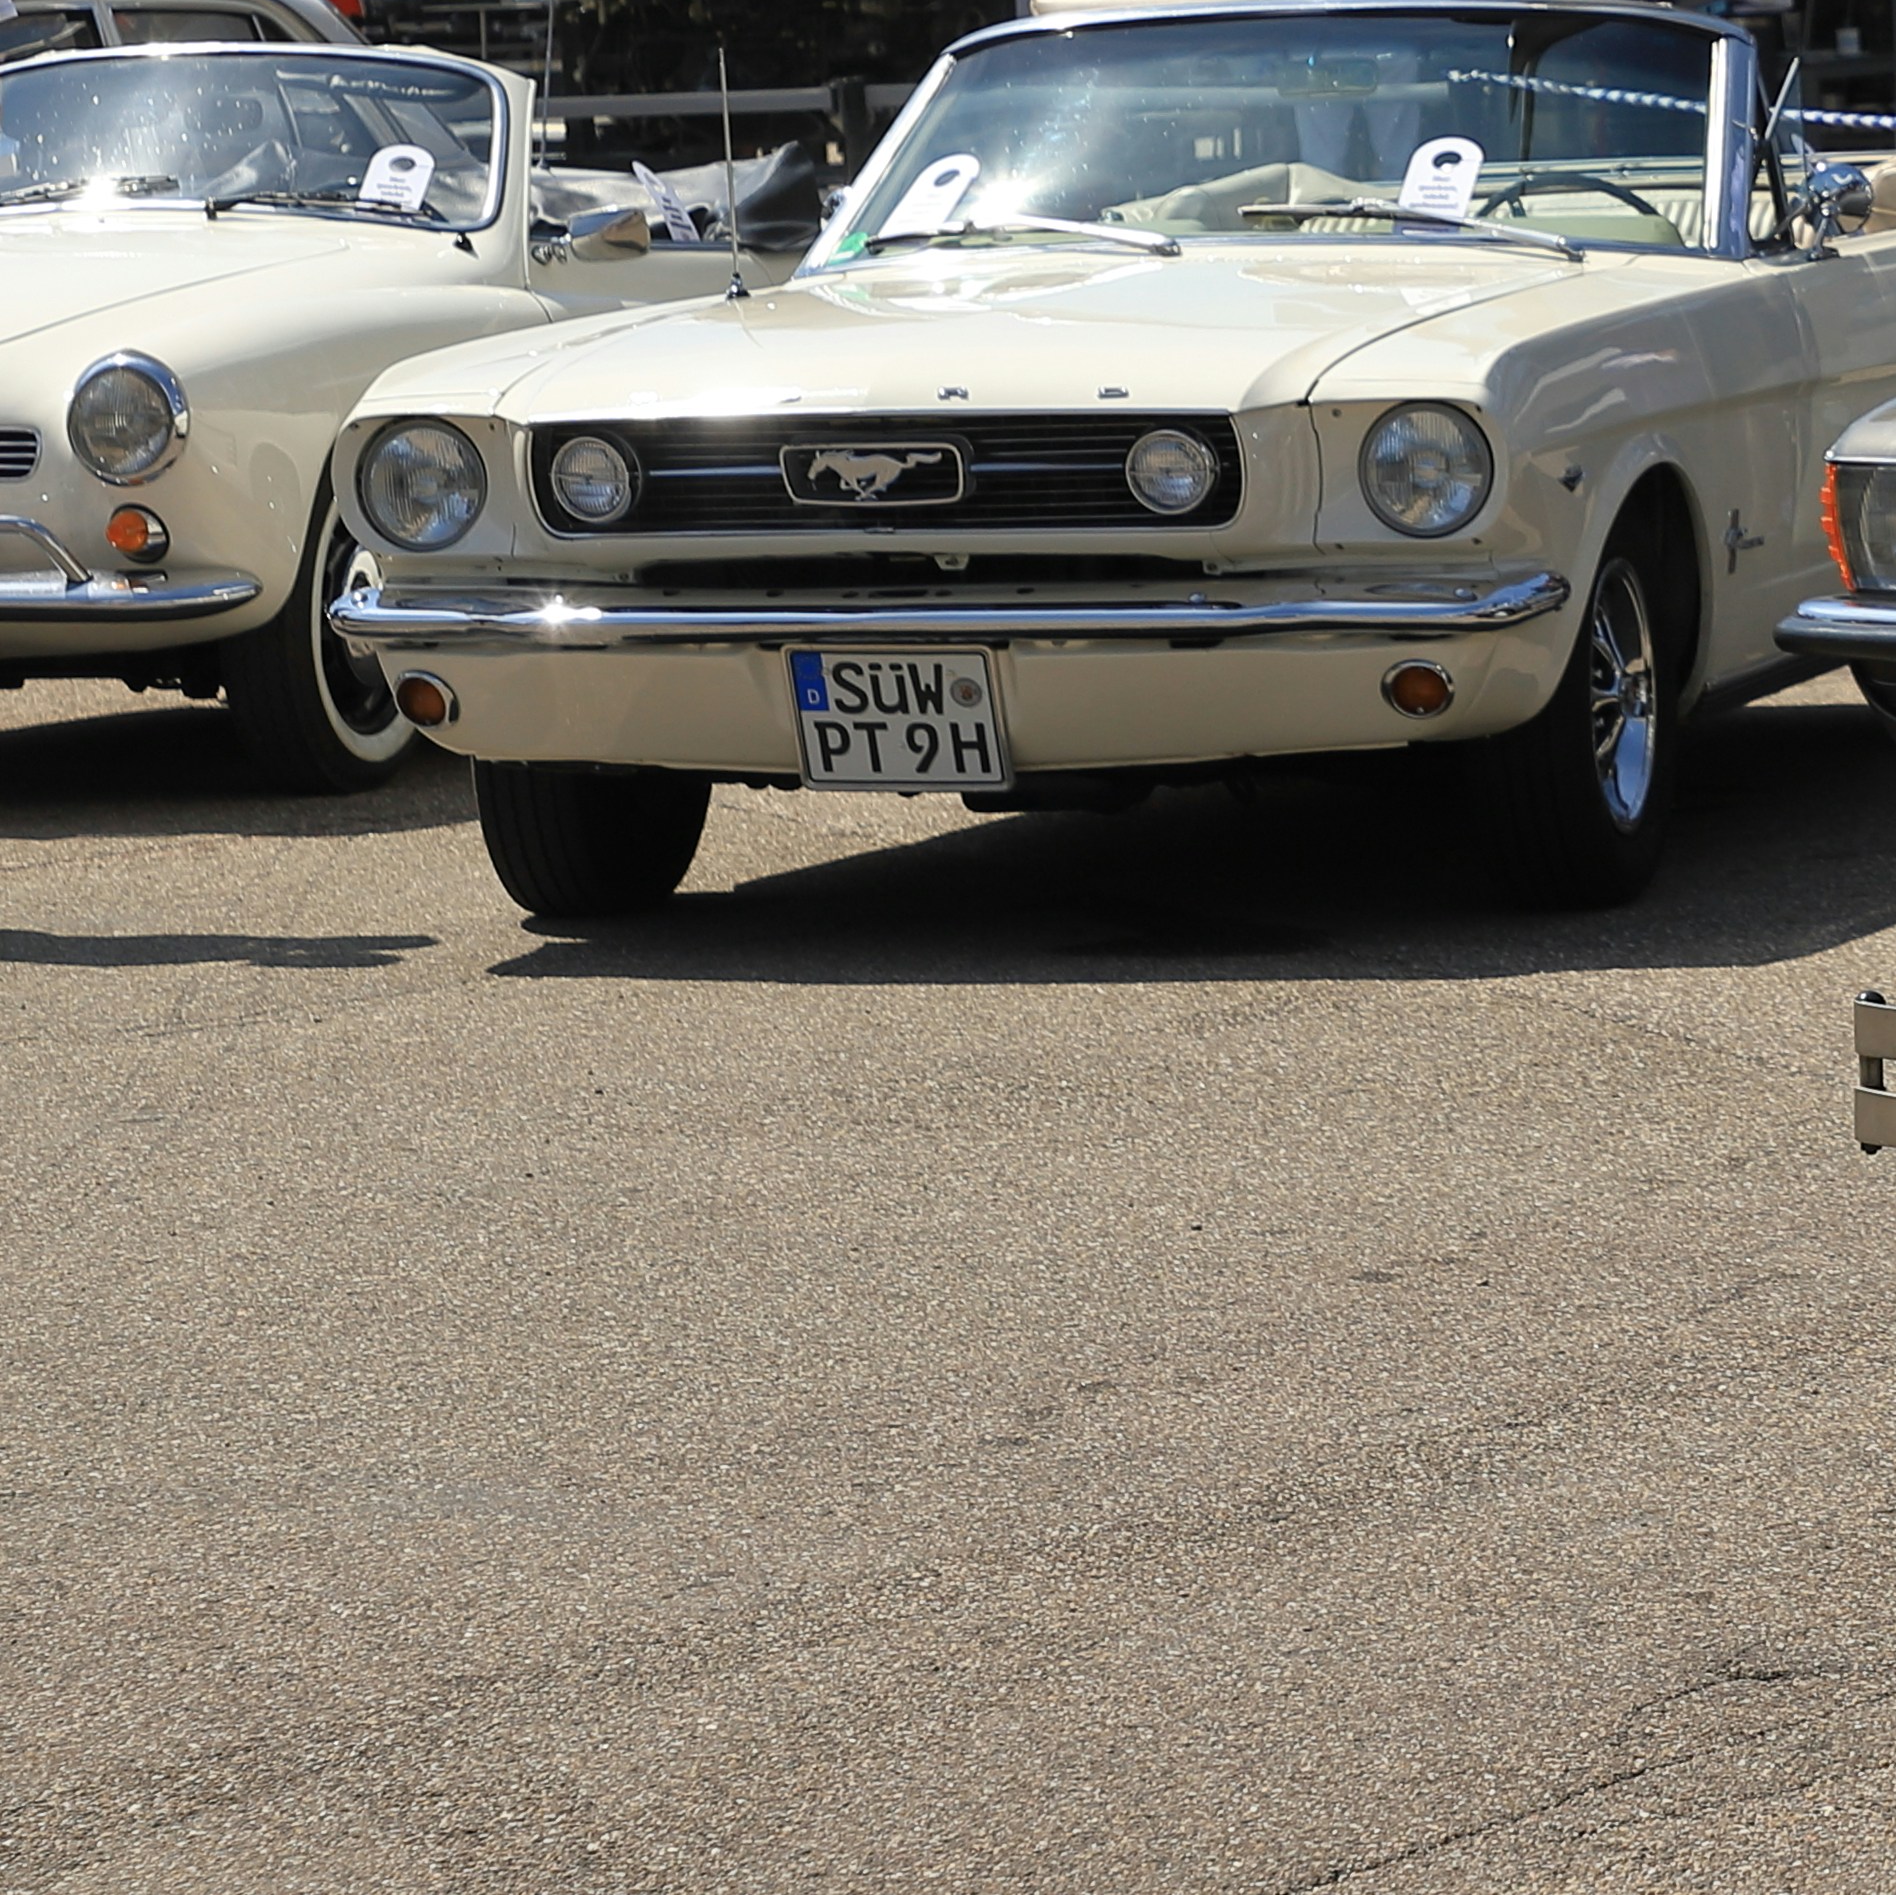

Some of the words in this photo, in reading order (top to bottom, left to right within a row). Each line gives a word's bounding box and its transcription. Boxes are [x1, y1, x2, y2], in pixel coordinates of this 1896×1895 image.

[808, 687, 821, 706] D
[814, 721, 888, 774] PT
[906, 721, 992, 775] 9H
